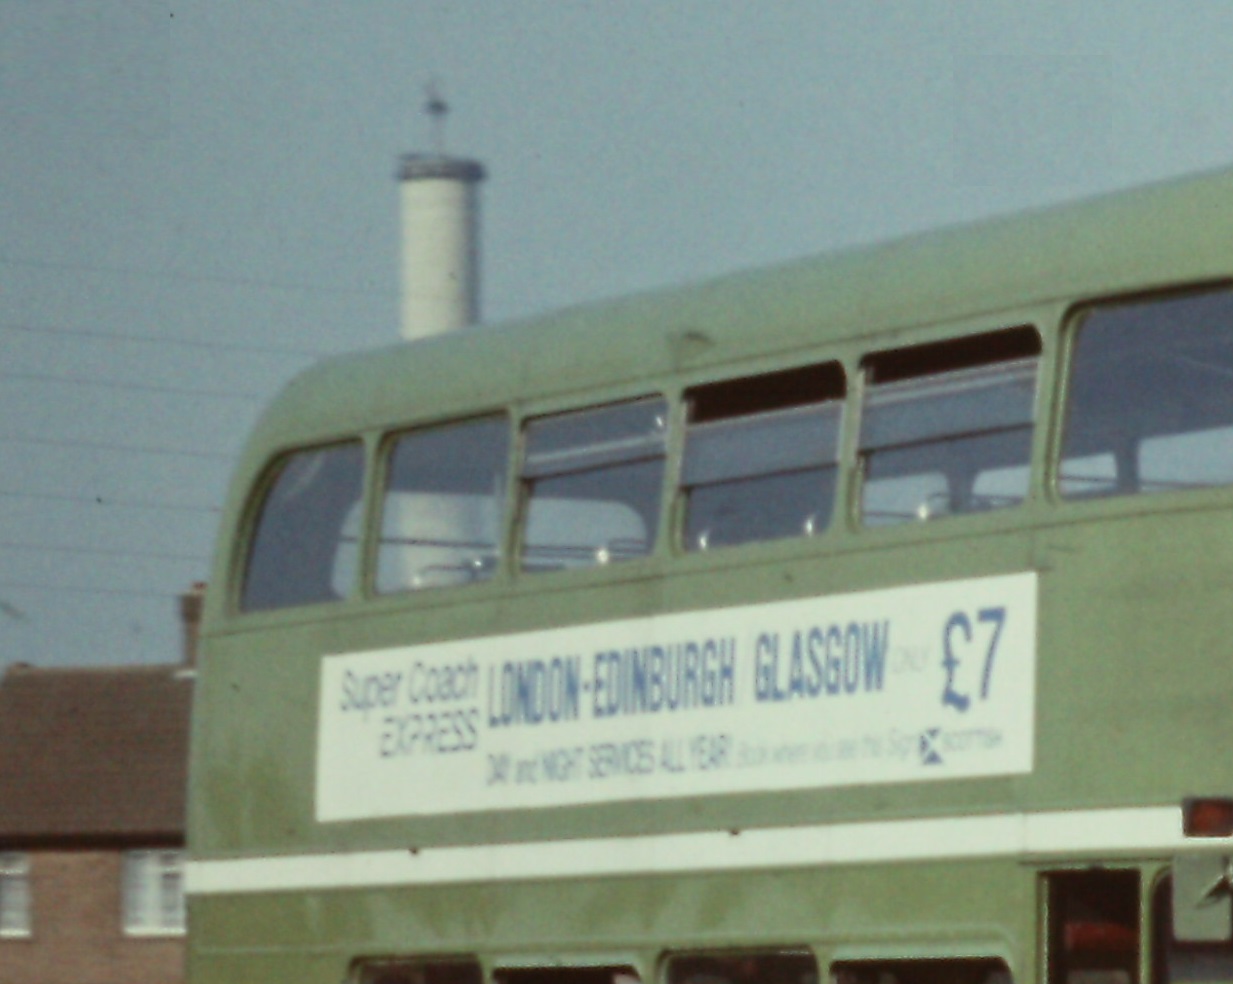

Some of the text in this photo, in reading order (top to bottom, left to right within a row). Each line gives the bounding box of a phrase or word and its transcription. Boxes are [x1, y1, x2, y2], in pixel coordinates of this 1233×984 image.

[755, 620, 890, 703] GLASGOW
[941, 606, 1007, 713] £7
[341, 656, 479, 721] Super Coach
[380, 708, 479, 758] EXPRESS
[589, 742, 656, 778] SERVICES
